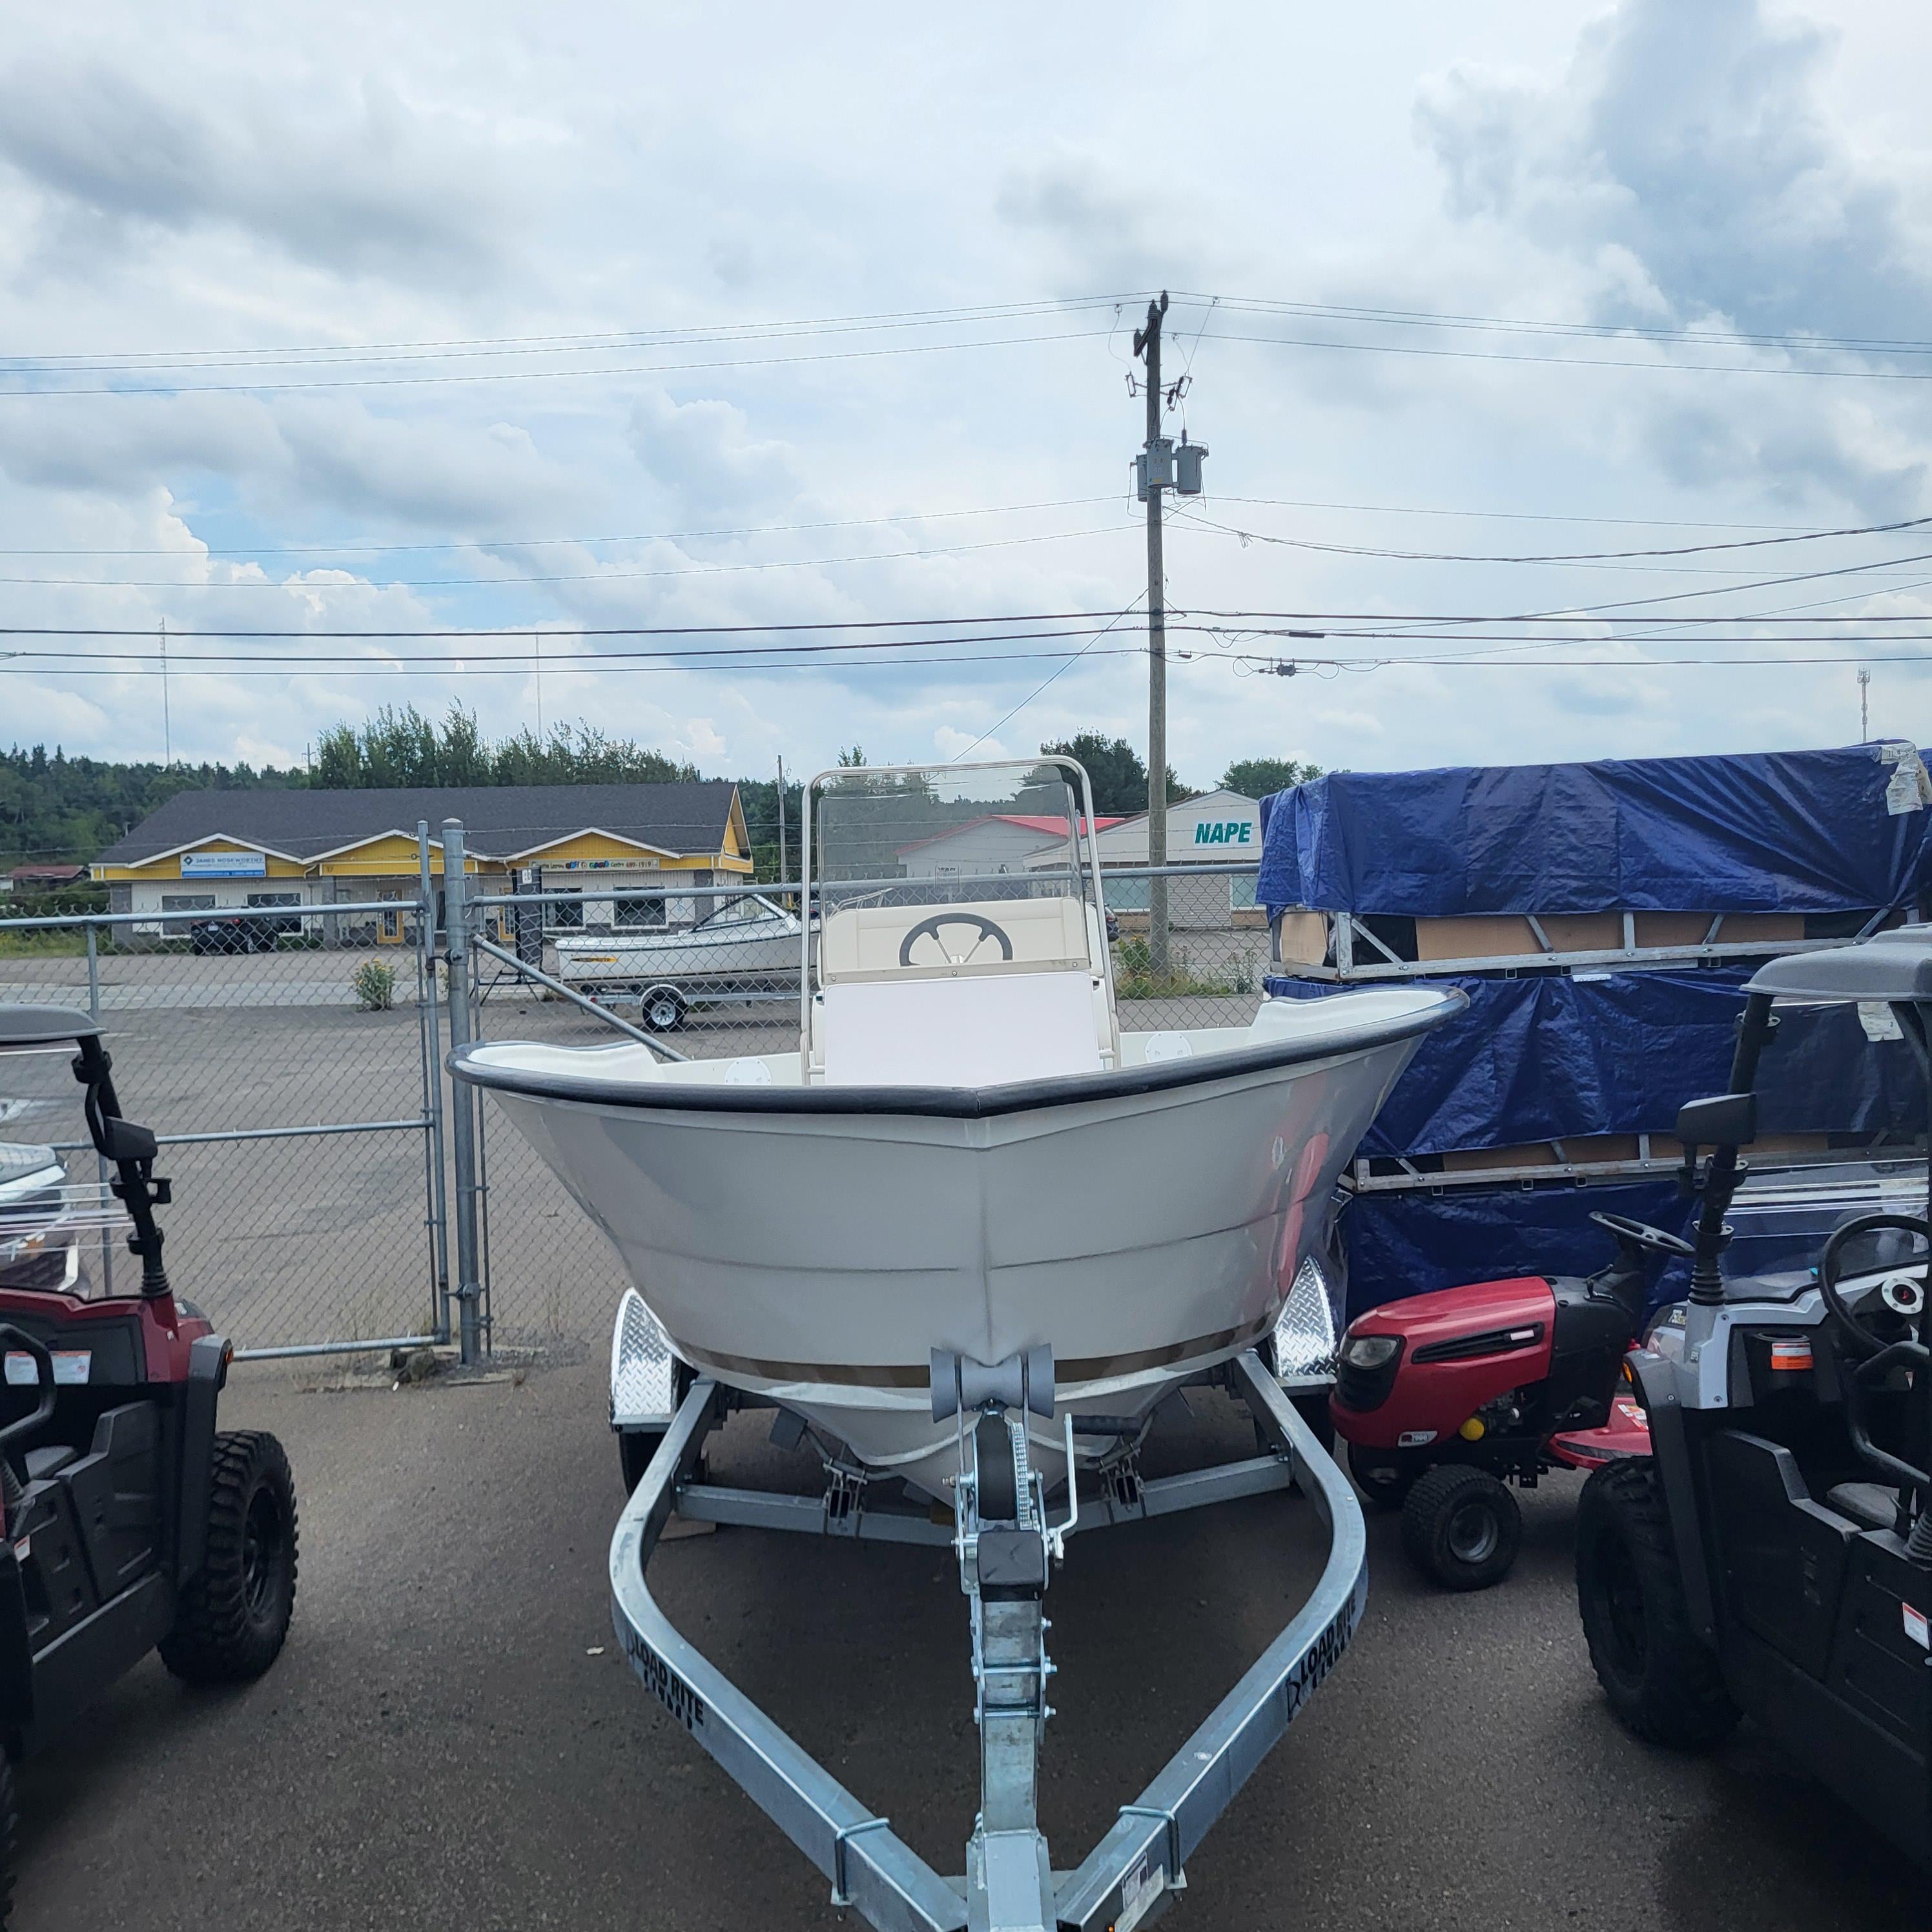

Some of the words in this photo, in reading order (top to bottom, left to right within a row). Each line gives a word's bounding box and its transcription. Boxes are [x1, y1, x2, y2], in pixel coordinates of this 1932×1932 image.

[1195, 822, 1253, 844] NAPE
[635, 1632, 668, 1687] LOAD
[671, 1673, 704, 1727] RITE
[1300, 1624, 1335, 1685] LOAD
